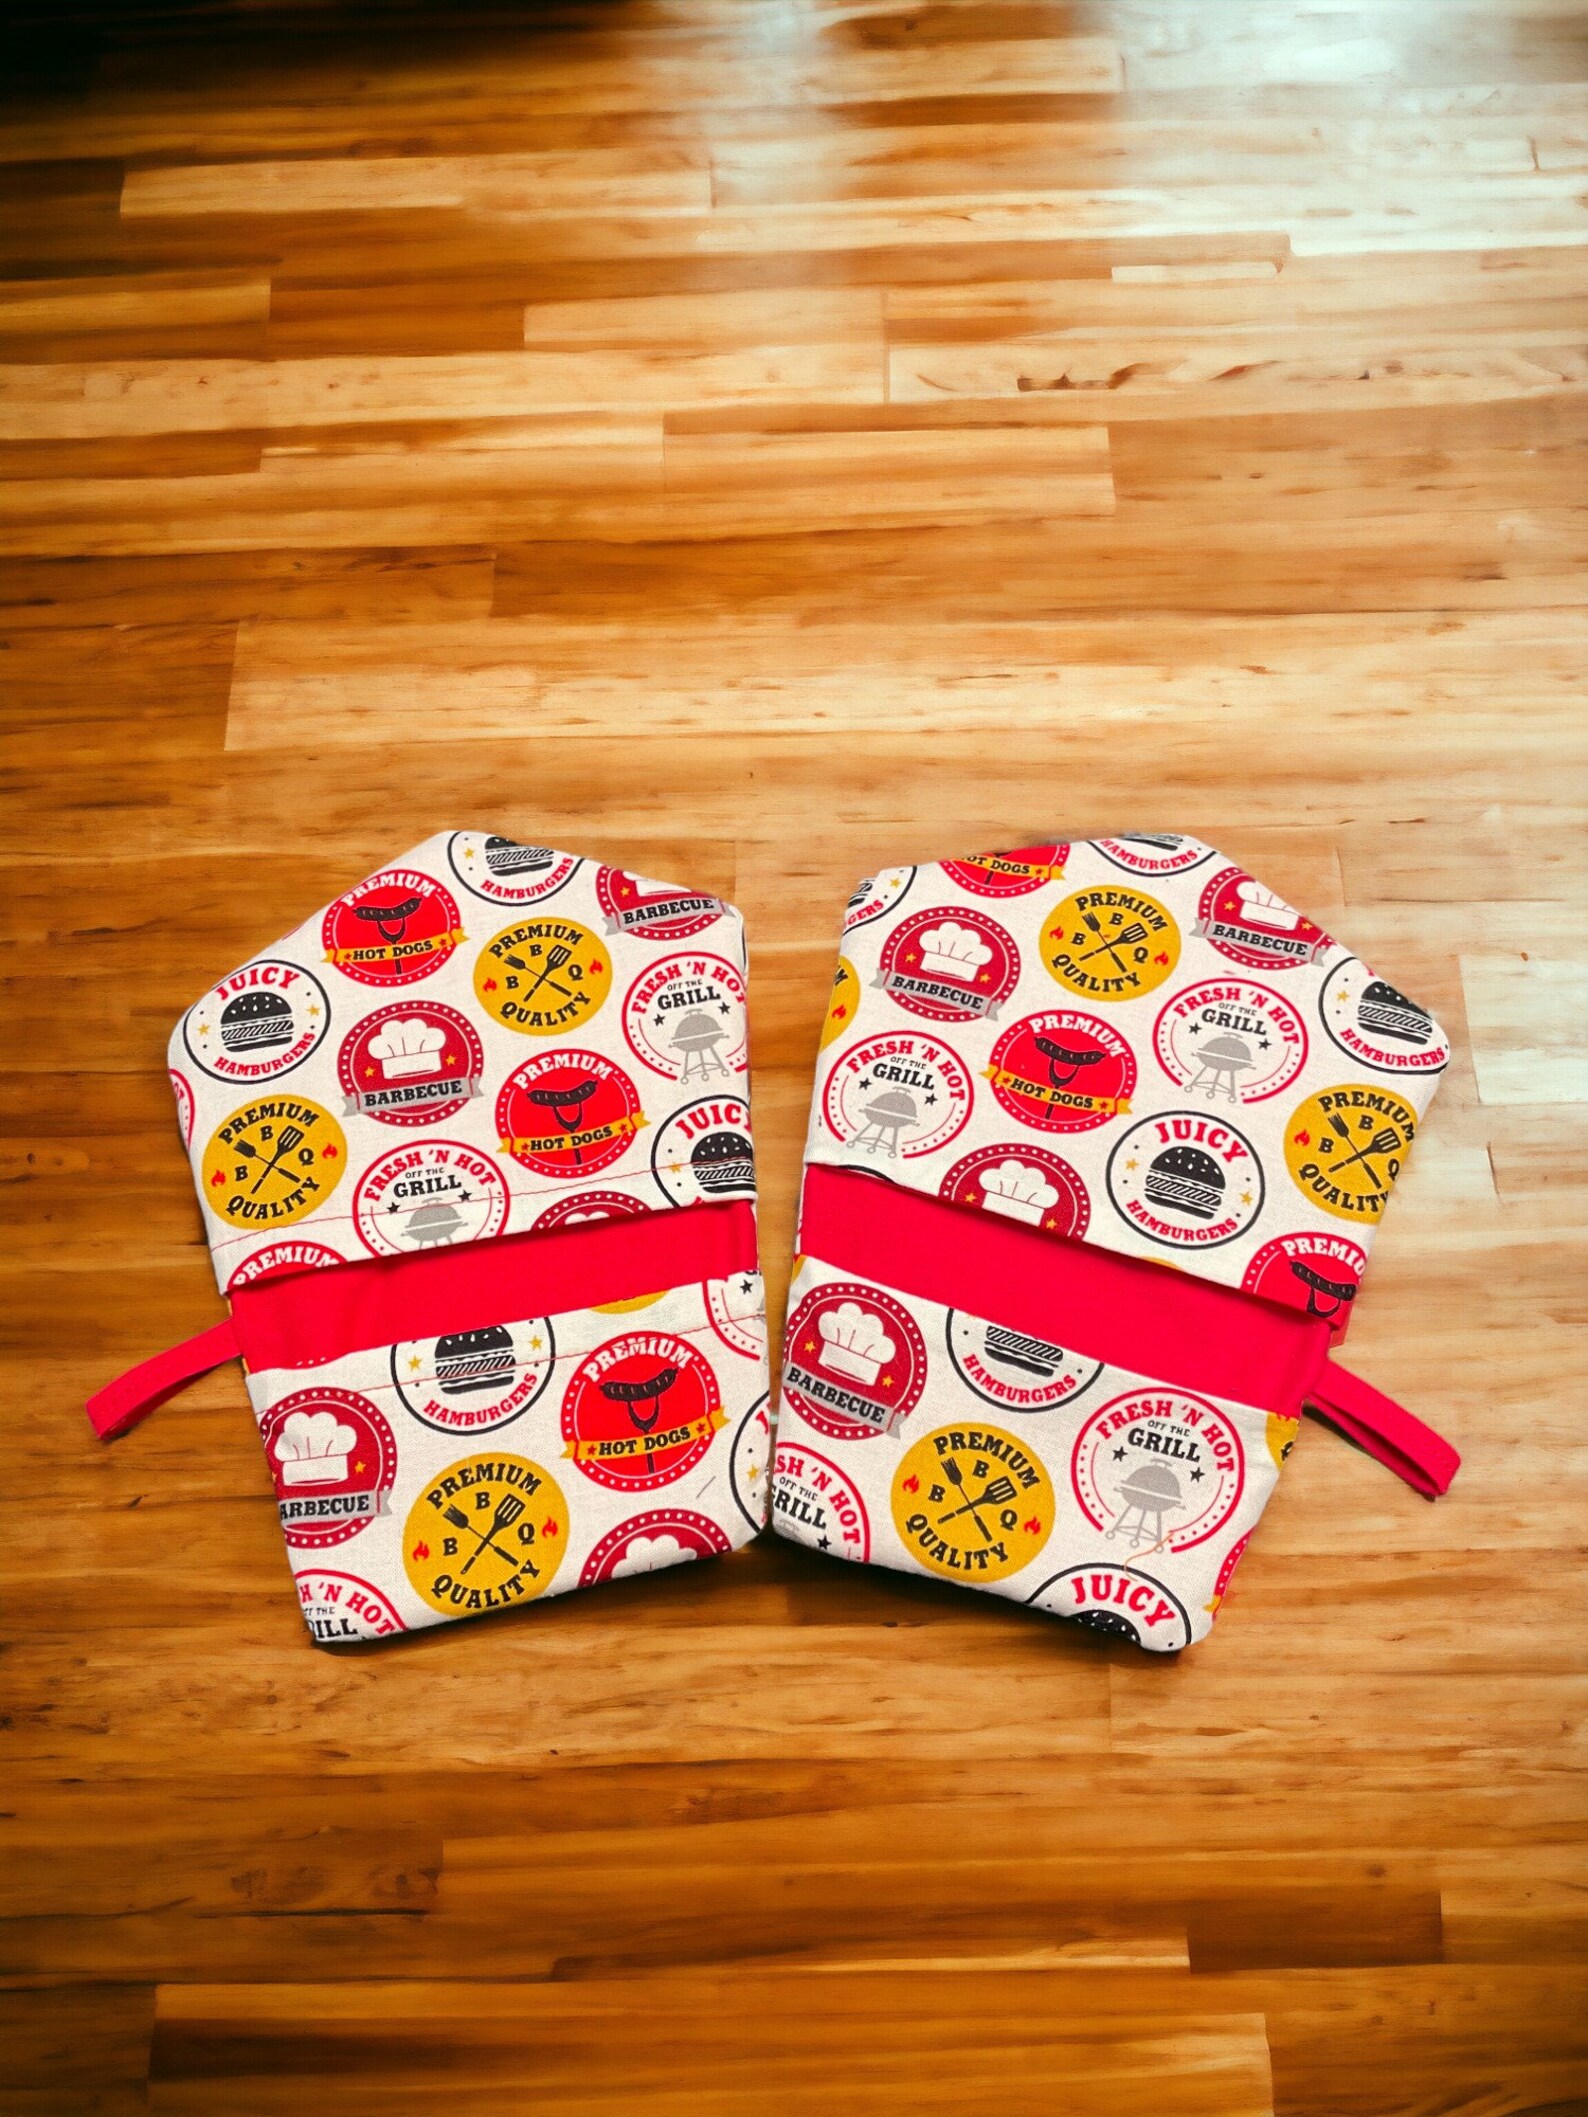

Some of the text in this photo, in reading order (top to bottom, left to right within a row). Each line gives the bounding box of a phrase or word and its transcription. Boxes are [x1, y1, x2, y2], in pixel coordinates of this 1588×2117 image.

[480, 857, 574, 899] HAMBURGERS
[990, 859, 1030, 874] DOGS
[340, 873, 437, 906] PREMIUM
[622, 899, 715, 924] BARBECUE
[1075, 892, 1168, 932] PREMIUM
[1109, 913, 1124, 925] B
[352, 940, 434, 961] HOT DOGS
[488, 923, 585, 958] PREMIUM
[530, 944, 543, 957] B
[1072, 933, 1086, 945] B
[1133, 946, 1148, 963] Q
[1212, 924, 1308, 956] BARBECUE
[215, 967, 300, 1001] JUICY
[505, 975, 520, 989] B
[568, 964, 583, 981] Q
[667, 979, 703, 992] OFF THE
[1052, 954, 1141, 992] QUALITY
[631, 964, 682, 1014] FRESH
[657, 986, 721, 1010] GRILL
[892, 976, 984, 1009] BARBECUE
[500, 991, 592, 1027] QUALITY
[1173, 987, 1241, 1018] FRESH
[1268, 1005, 1300, 1045] HOT
[1201, 1009, 1267, 1036] GRILL
[1218, 1001, 1257, 1016] OFF THE
[1028, 1014, 1126, 1058] PREMIUM
[1339, 1028, 1446, 1066] HAMBURGERS
[214, 1032, 316, 1076] HAMBURGERS
[890, 1056, 926, 1070] OFF THE
[512, 1053, 613, 1090] PREMIUM
[847, 1040, 913, 1073] FRESH
[937, 1059, 965, 1101] HOT
[873, 1063, 935, 1090] GRILL
[364, 1080, 463, 1107] BARBECUE
[1010, 1078, 1094, 1108] HOT DOGS
[218, 1101, 320, 1145] PREMIUM
[1318, 1091, 1415, 1142] PREMIUM
[1358, 1114, 1374, 1130] B
[260, 1125, 274, 1142] B
[529, 1126, 613, 1151] HOT DOGS
[1154, 1119, 1248, 1163] JUICY
[1318, 1137, 1334, 1153] B
[298, 1148, 315, 1166] Q
[235, 1165, 248, 1182] B
[363, 1151, 424, 1202] FRESH
[453, 1153, 497, 1186] HOT
[393, 1174, 462, 1198] GRILL
[405, 1167, 445, 1179] OFF THE
[225, 1176, 320, 1220] QUALITY
[1126, 1199, 1239, 1242] HAMBURGERS
[582, 1336, 694, 1383] PREMIUM
[962, 1353, 1078, 1404] HAMBURGERS
[423, 1372, 538, 1427] HAMBURGERS
[786, 1366, 886, 1424] BARBECUE
[598, 1426, 692, 1457] HOT DOGS
[1096, 1399, 1174, 1440] FRESH
[1201, 1419, 1235, 1473] HOT
[1147, 1420, 1192, 1437] OFF THE
[933, 1431, 1041, 1490] PREMIUM
[1127, 1427, 1202, 1463] GRILL
[973, 1459, 990, 1478] B
[426, 1461, 542, 1510] PREMIUM
[475, 1491, 491, 1510] B
[799, 1486, 819, 1502] THE
[928, 1484, 946, 1503] B
[280, 1494, 370, 1520] ARBECUE
[829, 1489, 861, 1544] HOT
[1000, 1508, 1018, 1531] Q
[443, 1537, 459, 1556] B
[517, 1523, 536, 1546] Q
[905, 1512, 1009, 1571] QUALITY
[431, 1559, 540, 1609] QUALITY
[345, 1591, 396, 1635] HOT
[1071, 1573, 1175, 1627] JUICY
